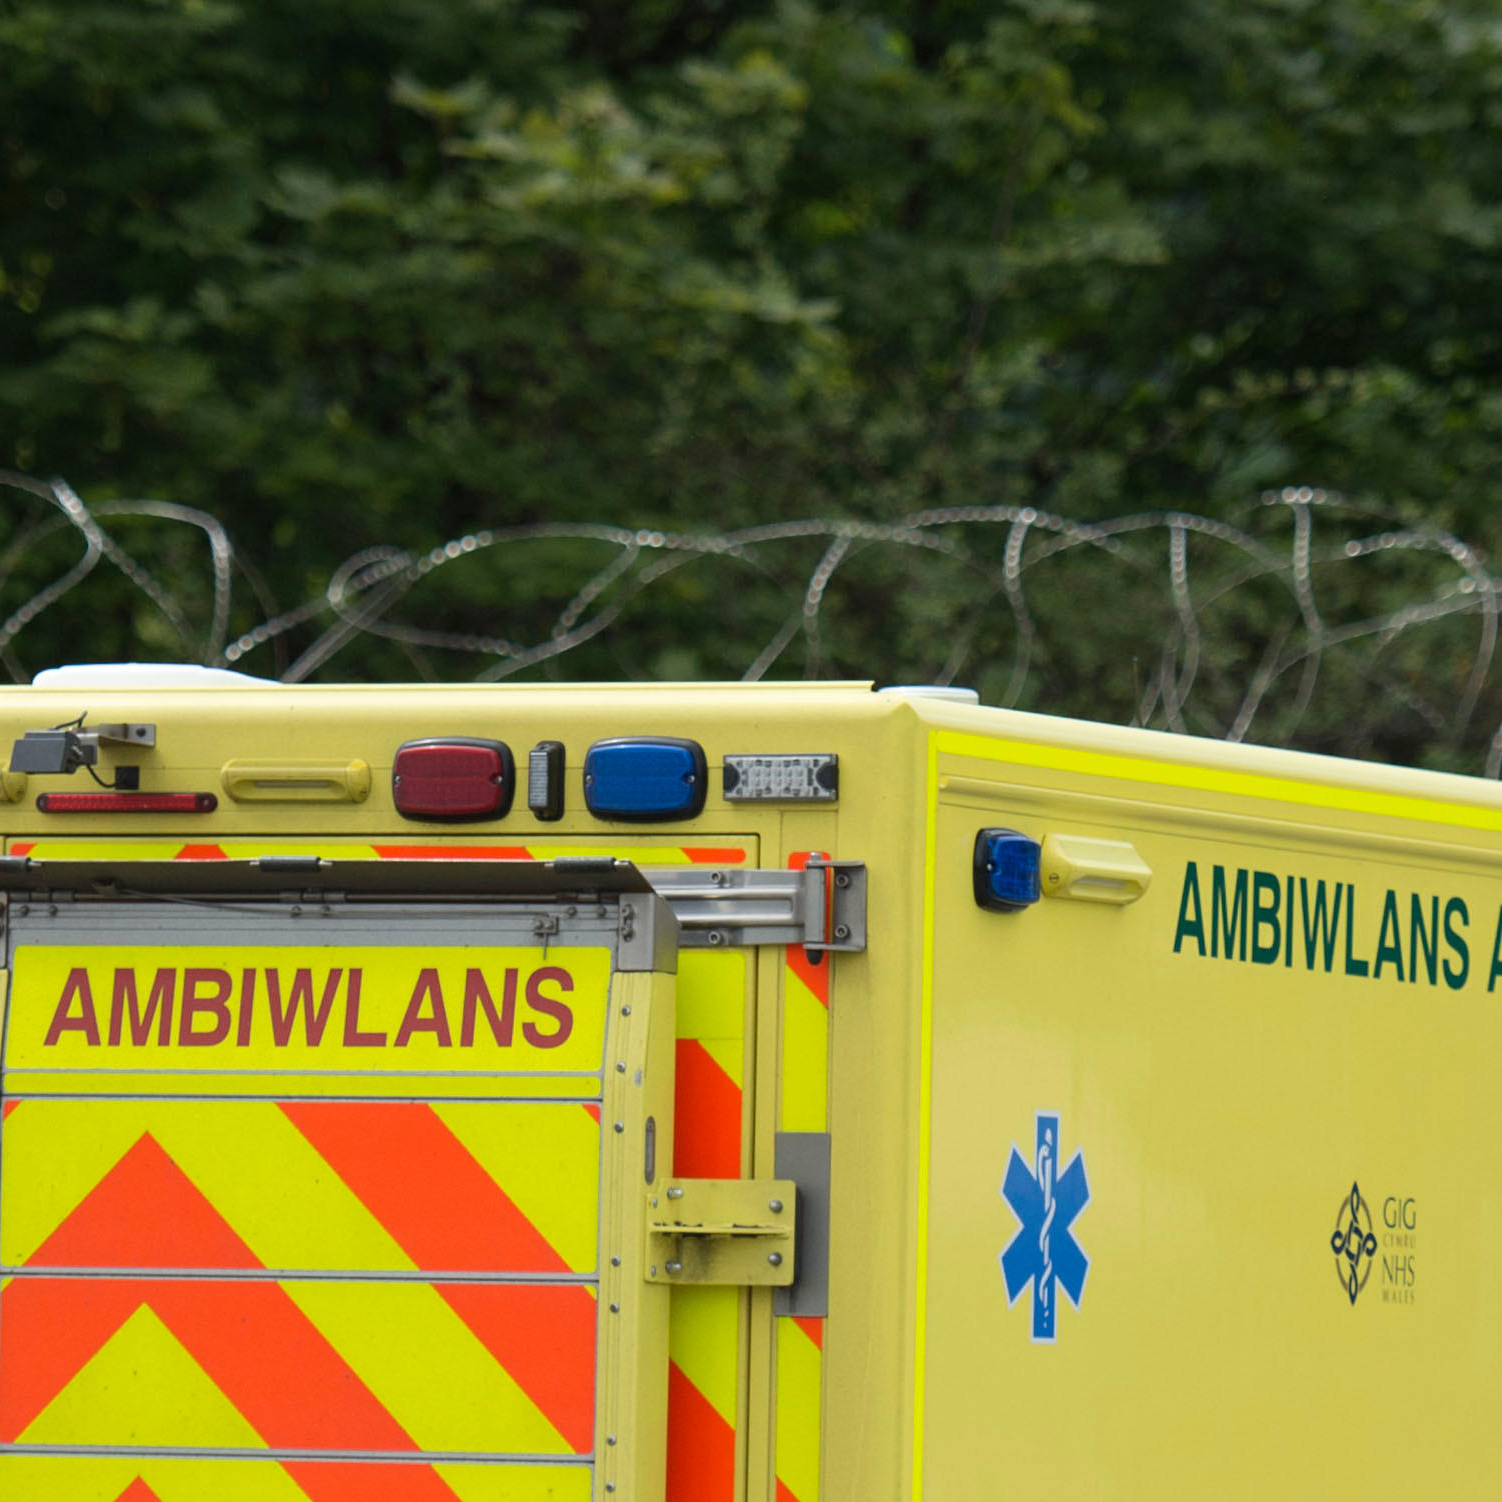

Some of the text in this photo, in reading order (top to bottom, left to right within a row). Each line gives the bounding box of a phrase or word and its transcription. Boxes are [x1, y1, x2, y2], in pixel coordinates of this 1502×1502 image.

[1173, 861, 1470, 991] AMBIWLANS
[43, 966, 574, 1049] AMBIWLANS
[1382, 1196, 1417, 1230] GIG
[1381, 1255, 1415, 1287] NHS
[1382, 1289, 1415, 1305] WALES
